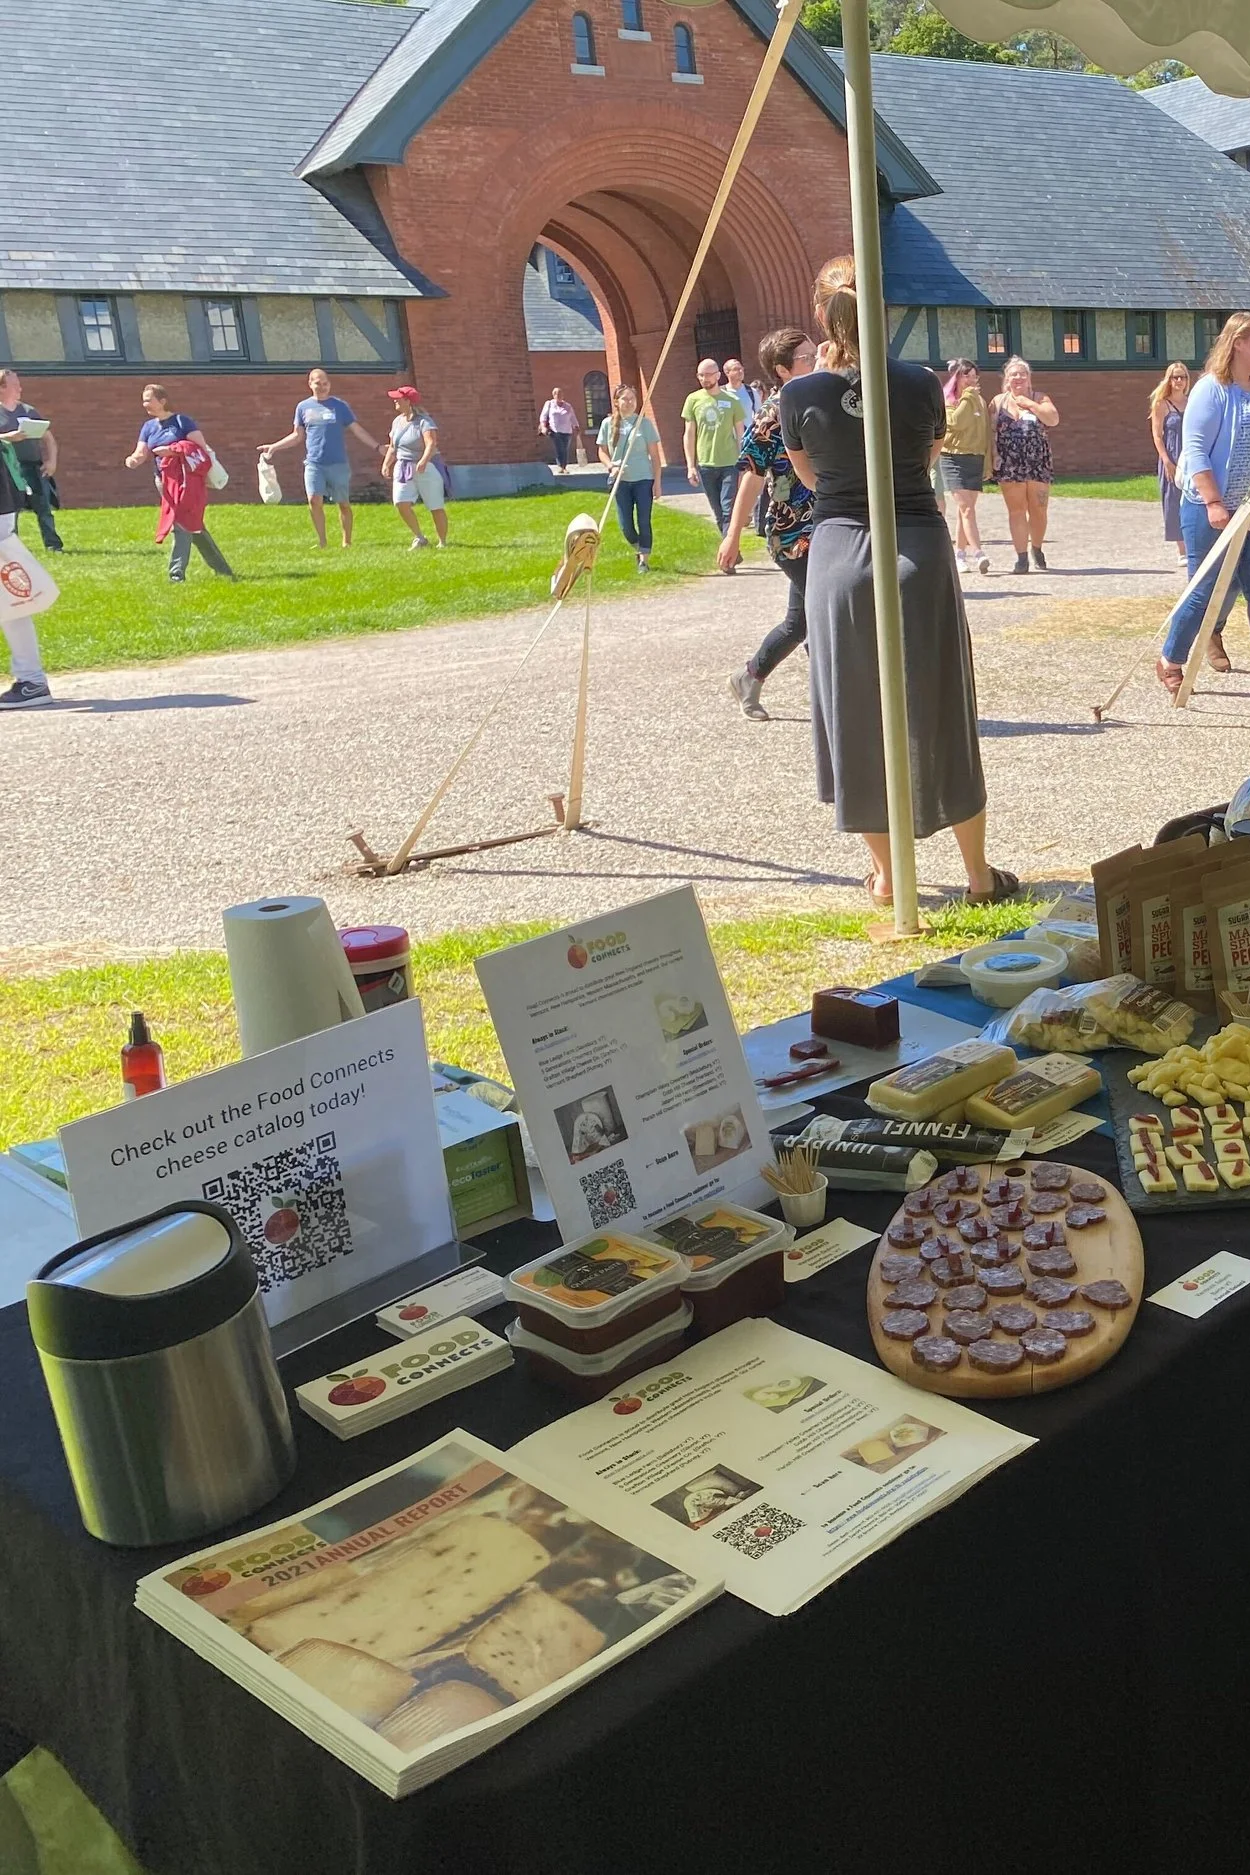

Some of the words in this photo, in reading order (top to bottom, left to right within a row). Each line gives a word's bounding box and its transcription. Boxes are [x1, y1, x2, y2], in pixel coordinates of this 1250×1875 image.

[586, 931, 628, 954] FOOD
[591, 944, 631, 963] CONNECTS
[110, 1129, 177, 1168] Check
[183, 1113, 217, 1142] out
[220, 1099, 253, 1127] the
[256, 1078, 306, 1114] Food
[309, 1046, 396, 1091] Connects
[155, 1138, 229, 1181] cheese
[233, 1108, 306, 1152] catalog
[309, 1082, 367, 1121] today!
[784, 1134, 878, 1155] JUNIPER
[881, 1119, 971, 1140] FENNEL
[380, 1330, 480, 1379] FOOD
[396, 1338, 494, 1386] CONNECTS
[635, 1371, 685, 1398] FOOD
[646, 1376, 693, 1402] CONNECTS
[227, 1532, 317, 1574] FOOD
[261, 1559, 317, 1588] 2021
[315, 1525, 396, 1567] ANNUAL
[394, 1483, 469, 1528] REPORT
[241, 1540, 327, 1579] CONNECTS
